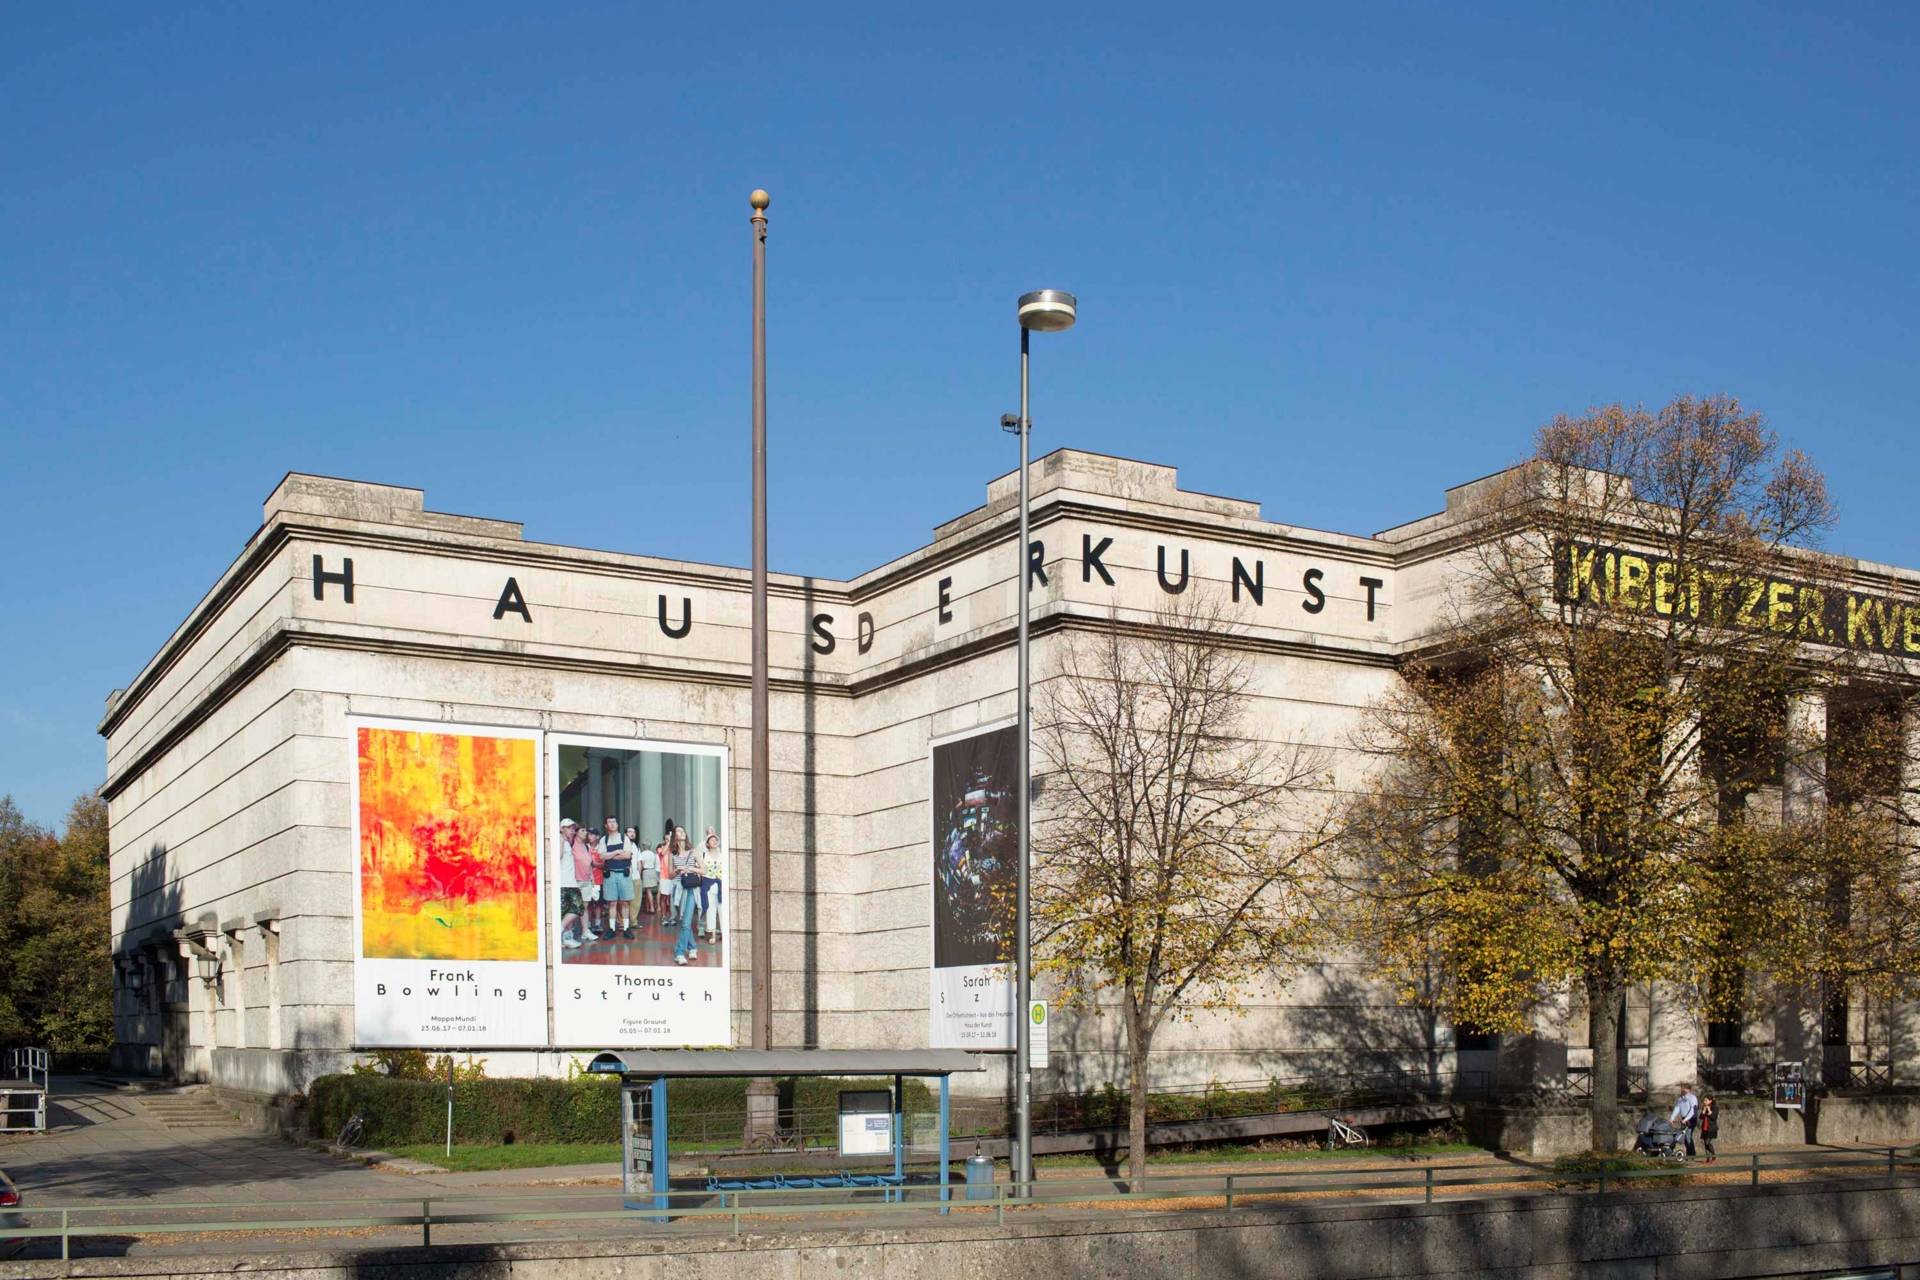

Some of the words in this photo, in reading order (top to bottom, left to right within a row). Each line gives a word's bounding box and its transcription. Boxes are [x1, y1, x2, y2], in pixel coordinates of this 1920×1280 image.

[313, 554, 836, 655] HAUS
[857, 540, 1048, 654] DER
[1082, 534, 1383, 621] KUNST
[430, 969, 475, 982] Frank
[614, 974, 673, 987] Thomas
[963, 975, 990, 988] Sarah
[376, 984, 527, 1001] Bowling
[573, 988, 712, 1002] Struth
